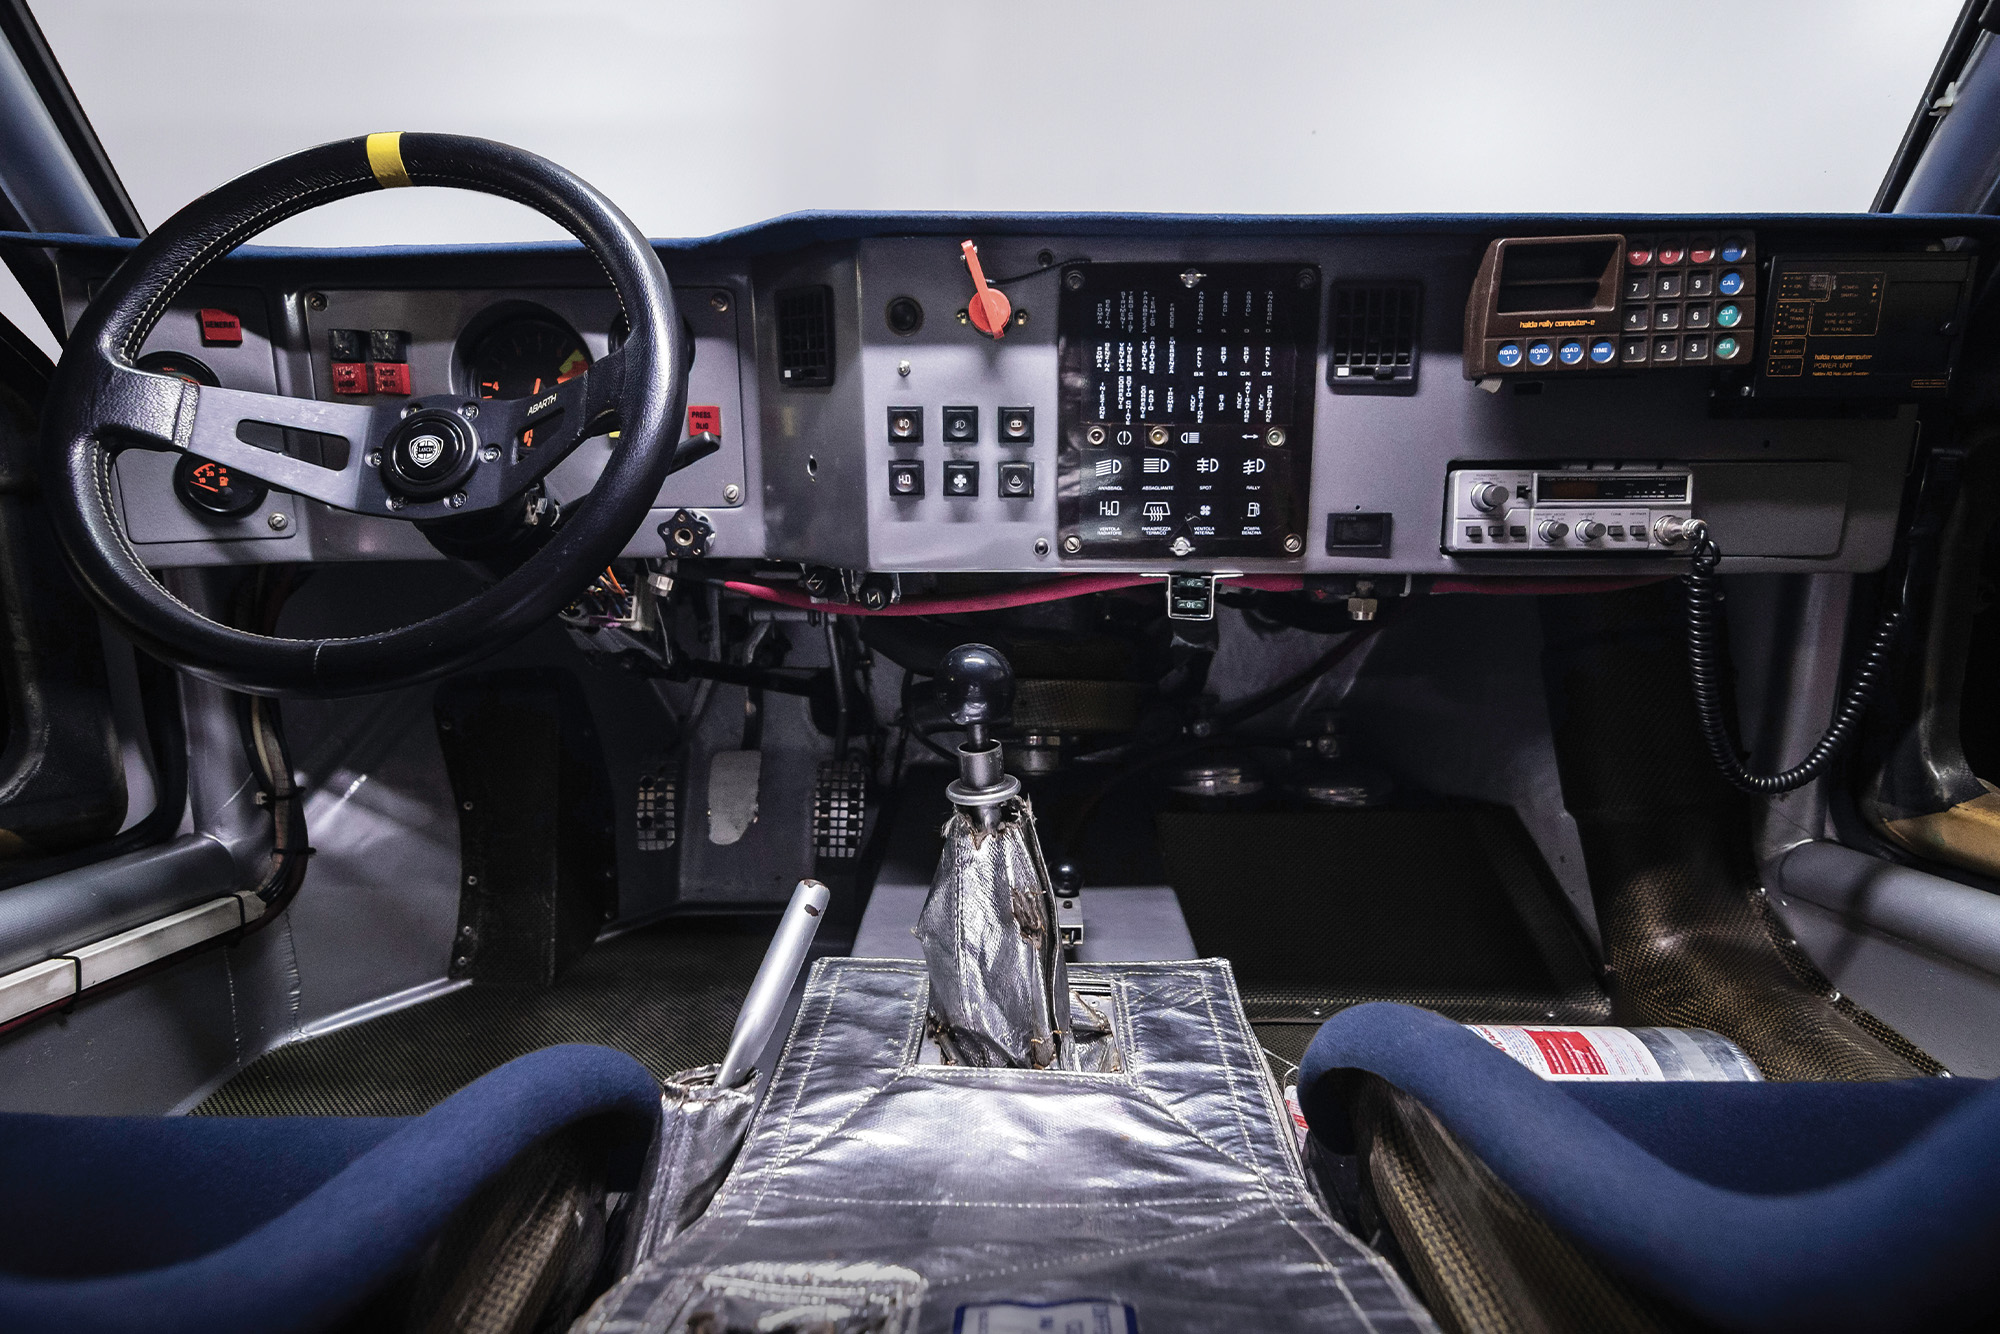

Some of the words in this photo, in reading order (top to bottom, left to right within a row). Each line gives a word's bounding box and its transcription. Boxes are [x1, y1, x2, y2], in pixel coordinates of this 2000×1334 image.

[1632, 283, 1639, 292] 7
[1663, 281, 1670, 291] 8
[1694, 279, 1701, 289] 9
[1630, 314, 1637, 323] 4
[1662, 313, 1669, 322] 5
[1692, 311, 1699, 321] 6
[1519, 320, 1538, 328] halda
[1629, 345, 1635, 355] 1
[1660, 344, 1667, 354] 2
[1691, 343, 1698, 352] 3
[492, 381, 500, 392] 4
[527, 392, 557, 417] ABARTH
